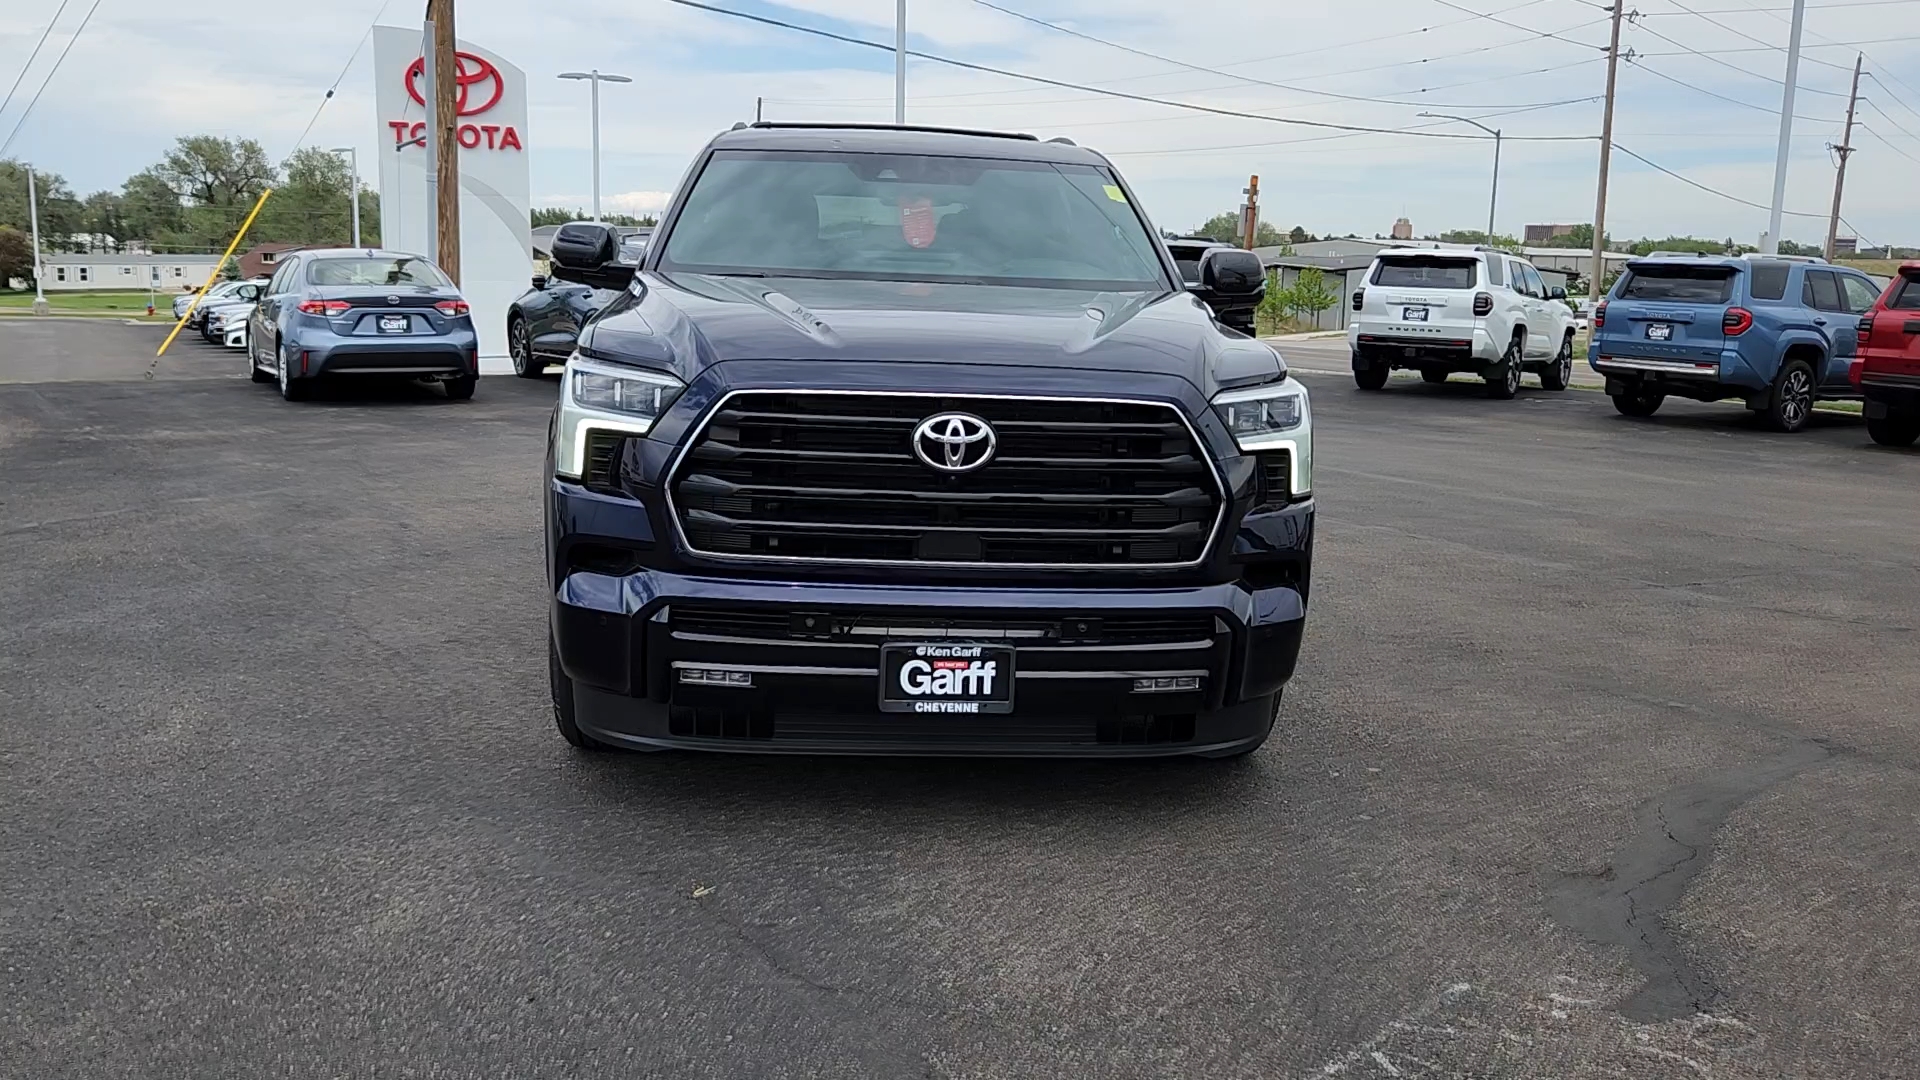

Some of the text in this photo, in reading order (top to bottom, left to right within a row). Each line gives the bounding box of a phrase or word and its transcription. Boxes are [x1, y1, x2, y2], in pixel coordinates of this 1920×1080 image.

[388, 121, 522, 150] TOOTA
[380, 319, 407, 329] Garff
[1648, 327, 1670, 337] Garff
[927, 646, 982, 657] Ken Garff
[900, 660, 996, 695] Garff
[915, 702, 979, 713] CHEYENNE
